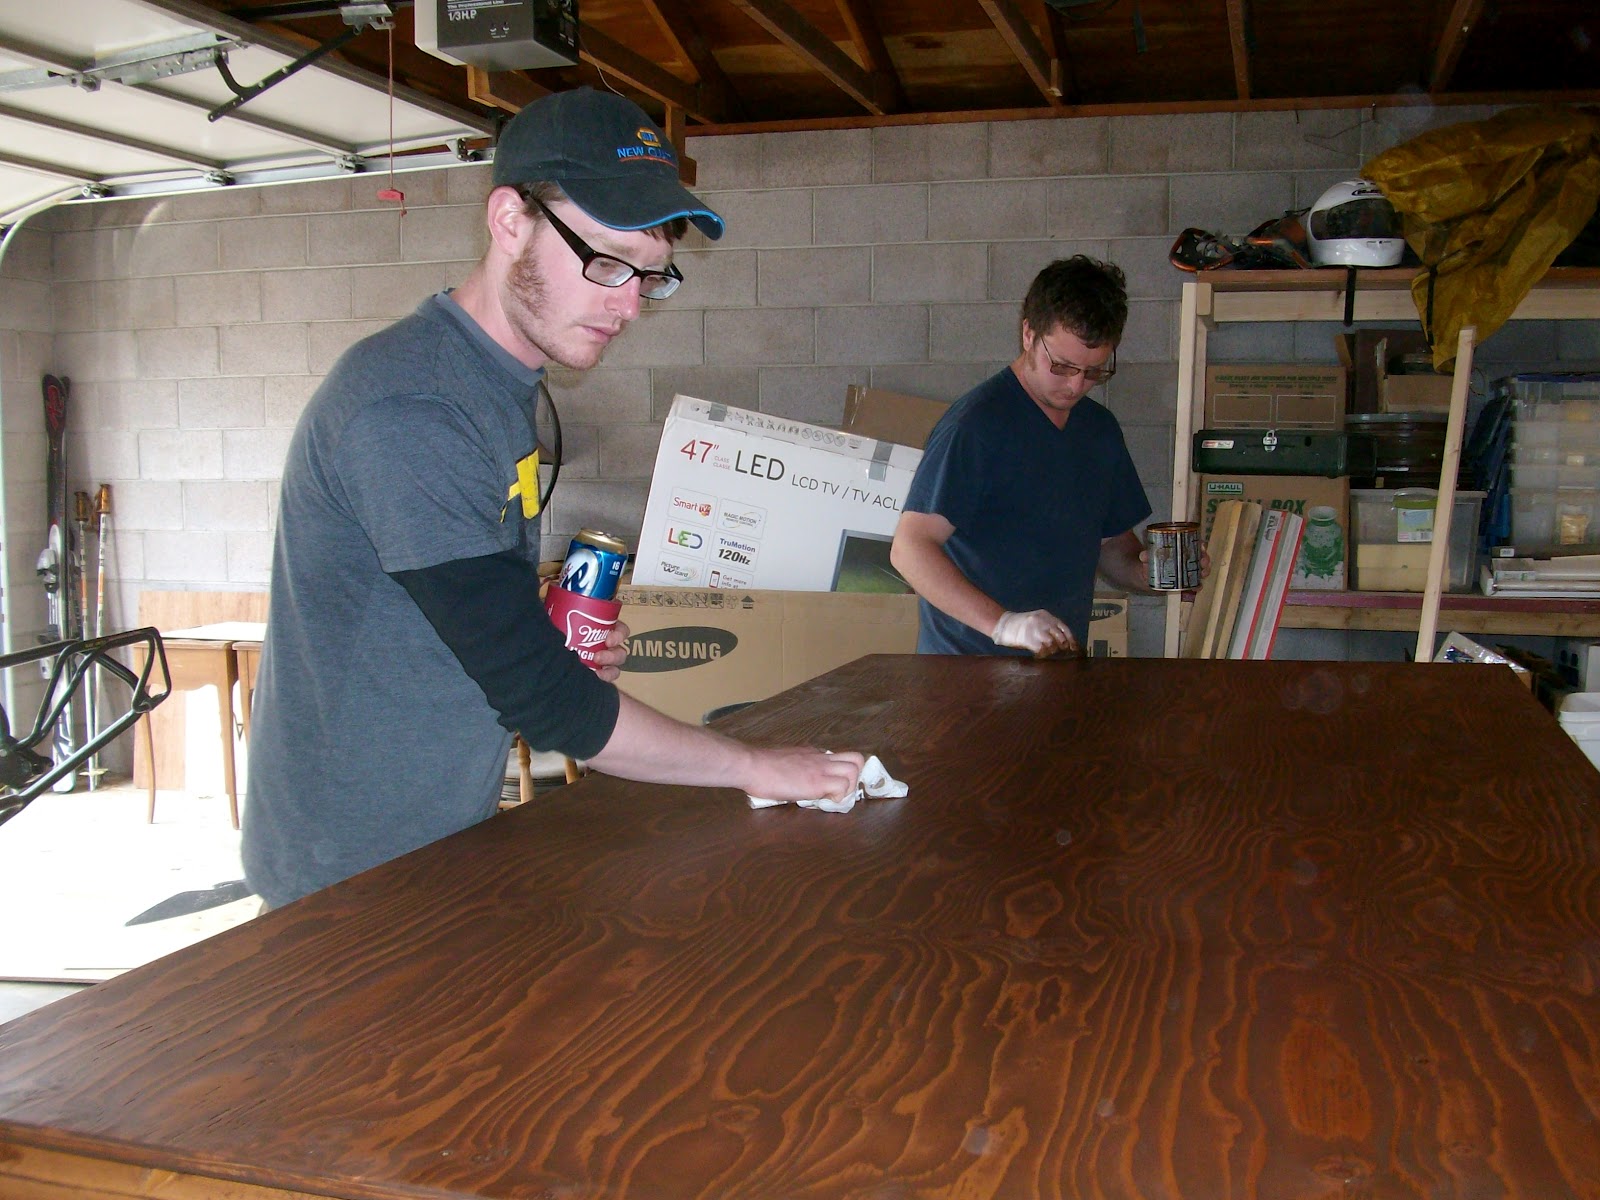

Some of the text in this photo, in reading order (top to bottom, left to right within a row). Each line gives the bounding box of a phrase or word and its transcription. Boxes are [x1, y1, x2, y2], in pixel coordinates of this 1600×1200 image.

[617, 146, 644, 158] NEW
[713, 462, 731, 470] CLASSE
[714, 455, 730, 463] CLASS
[735, 450, 785, 481] LED
[791, 474, 819, 491] LCD
[822, 481, 840, 496] TV
[852, 488, 871, 503] TV
[872, 494, 900, 511] ACL
[673, 497, 698, 511] Smart
[723, 512, 757, 524] MAGIC MOTION
[668, 527, 703, 550] LED
[720, 538, 756, 553] TruMotion
[718, 548, 751, 566] 120Hz
[661, 561, 681, 570] Picture
[663, 566, 689, 578] Wizard
[579, 626, 614, 642] Mill
[619, 639, 721, 660] SAMSUNG
